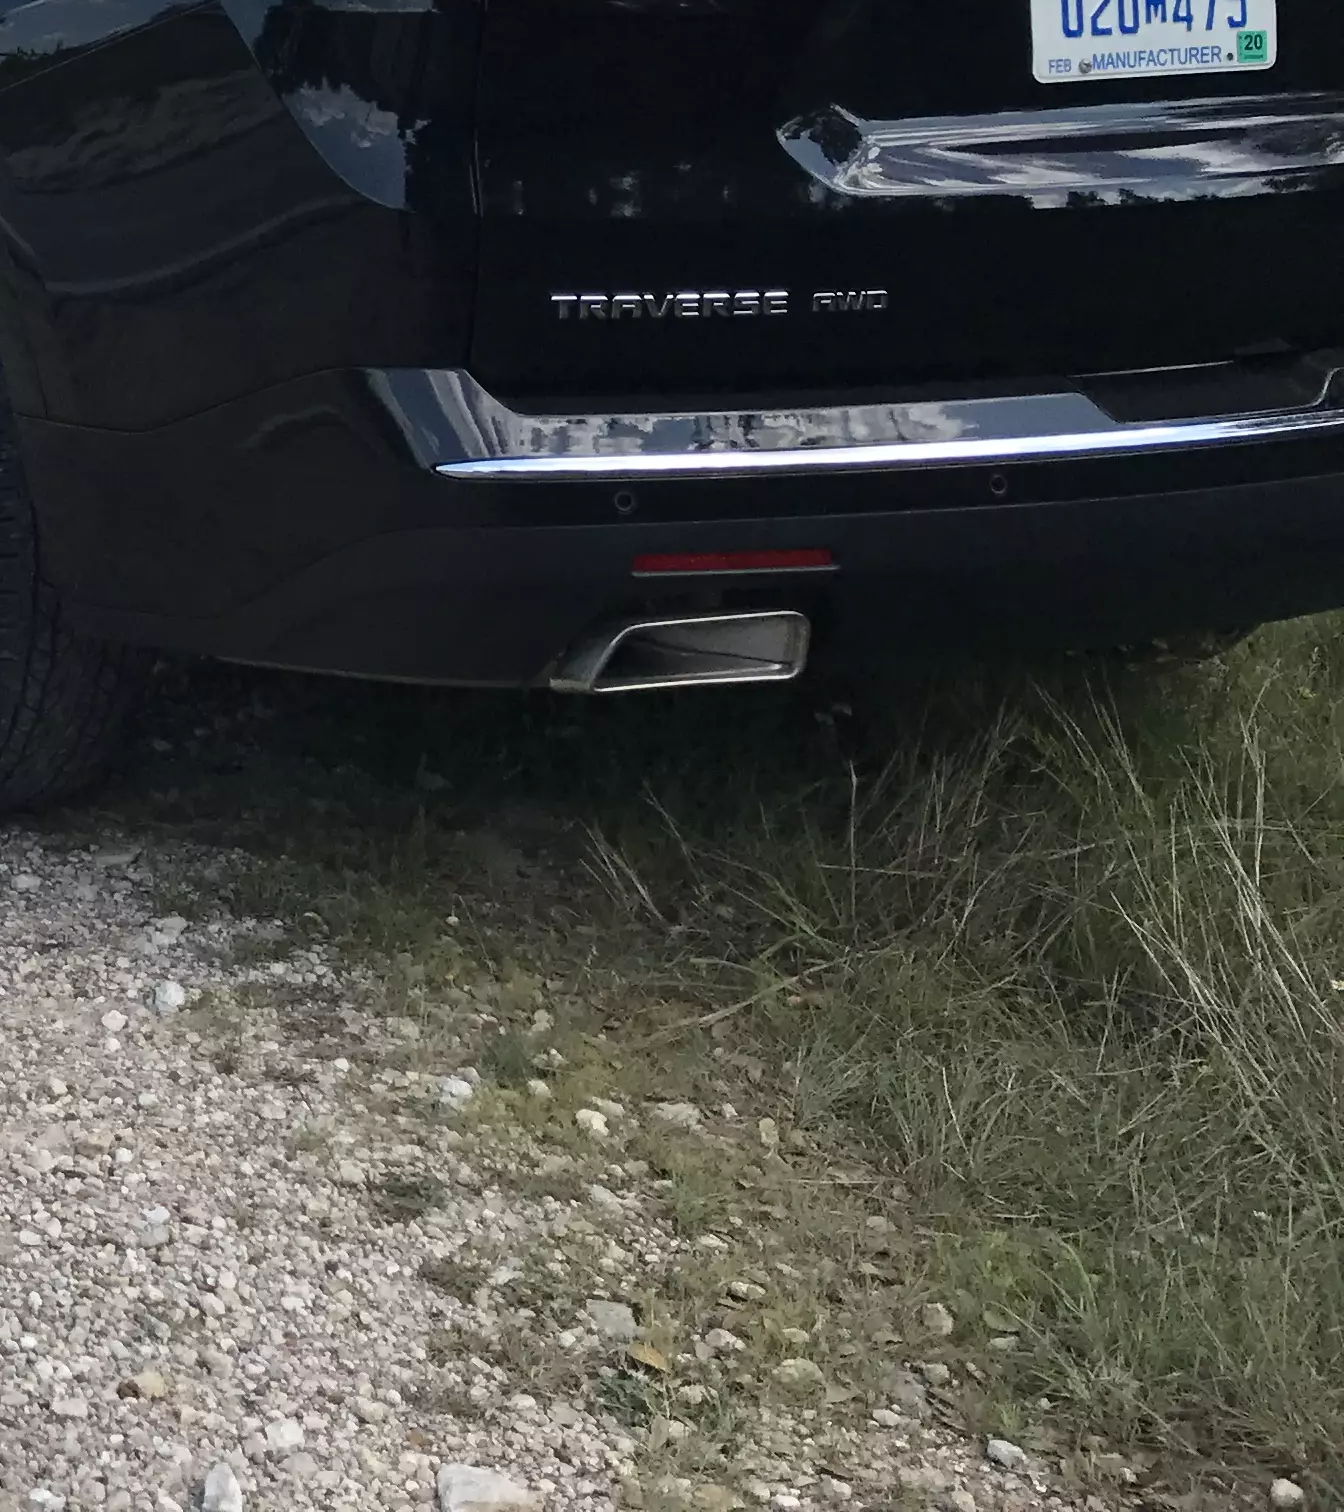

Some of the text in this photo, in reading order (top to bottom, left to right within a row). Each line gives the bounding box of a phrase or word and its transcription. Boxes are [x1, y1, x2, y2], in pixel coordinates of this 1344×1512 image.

[1244, 33, 1264, 50] 20
[1048, 45, 1222, 74] FEB MANUFACTURER
[550, 289, 889, 320] TRAVERSE AWD
